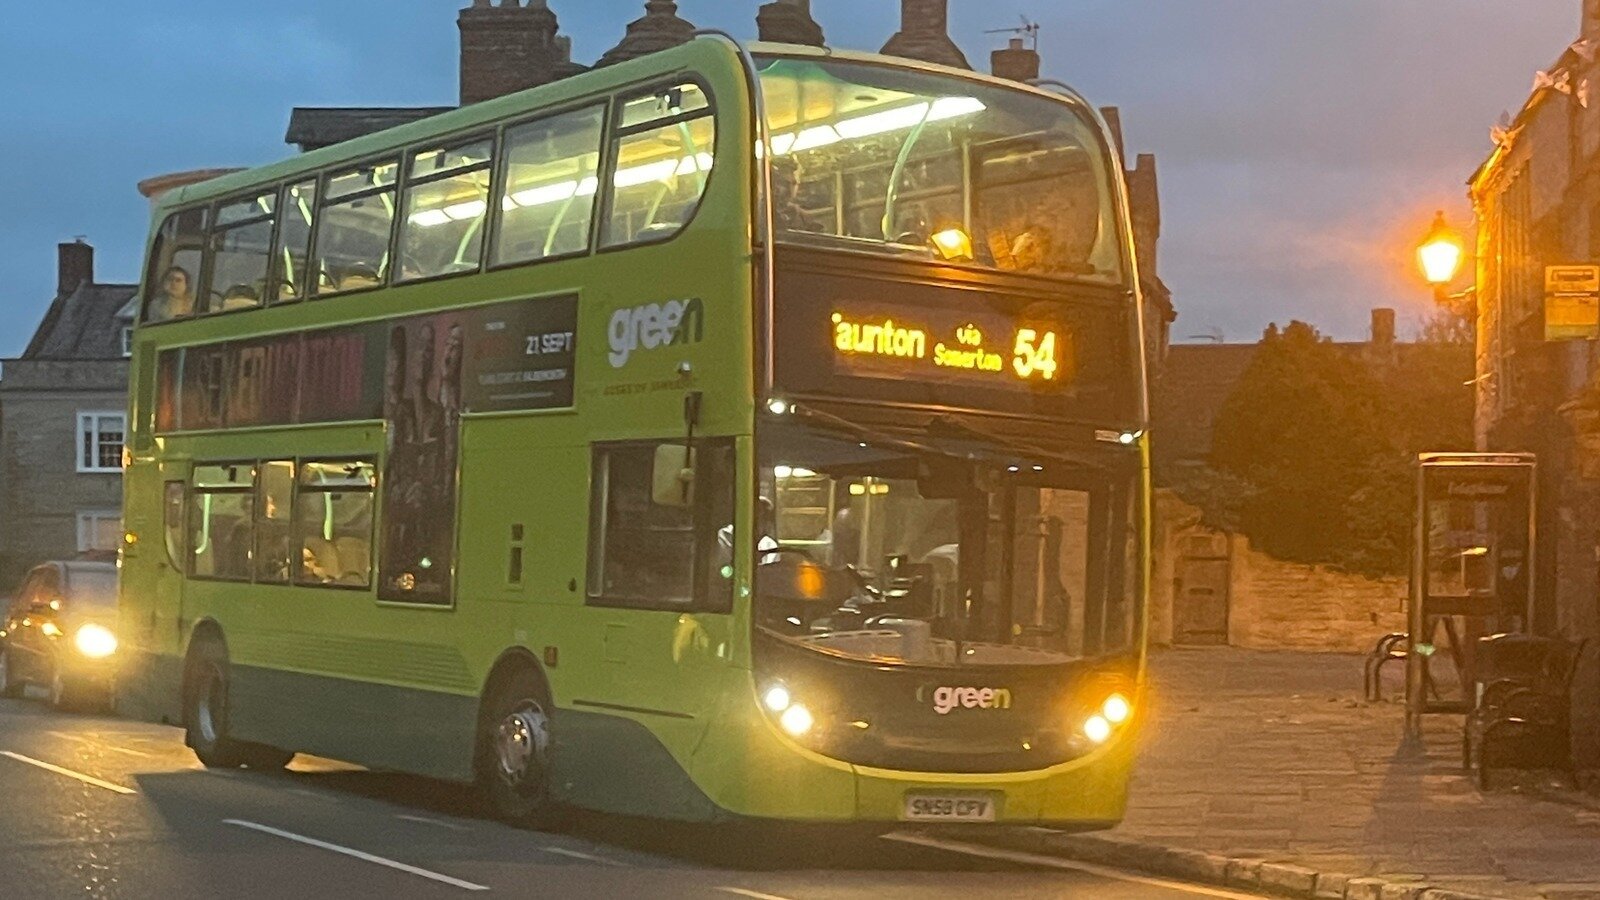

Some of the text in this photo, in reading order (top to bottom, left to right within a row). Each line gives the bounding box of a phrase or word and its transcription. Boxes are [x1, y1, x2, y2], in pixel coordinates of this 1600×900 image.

[542, 332, 573, 354] SEPT
[608, 297, 703, 367] green
[832, 313, 926, 358] aunton
[956, 324, 981, 346] via
[1013, 329, 1057, 379] 54
[933, 686, 1011, 714] green
